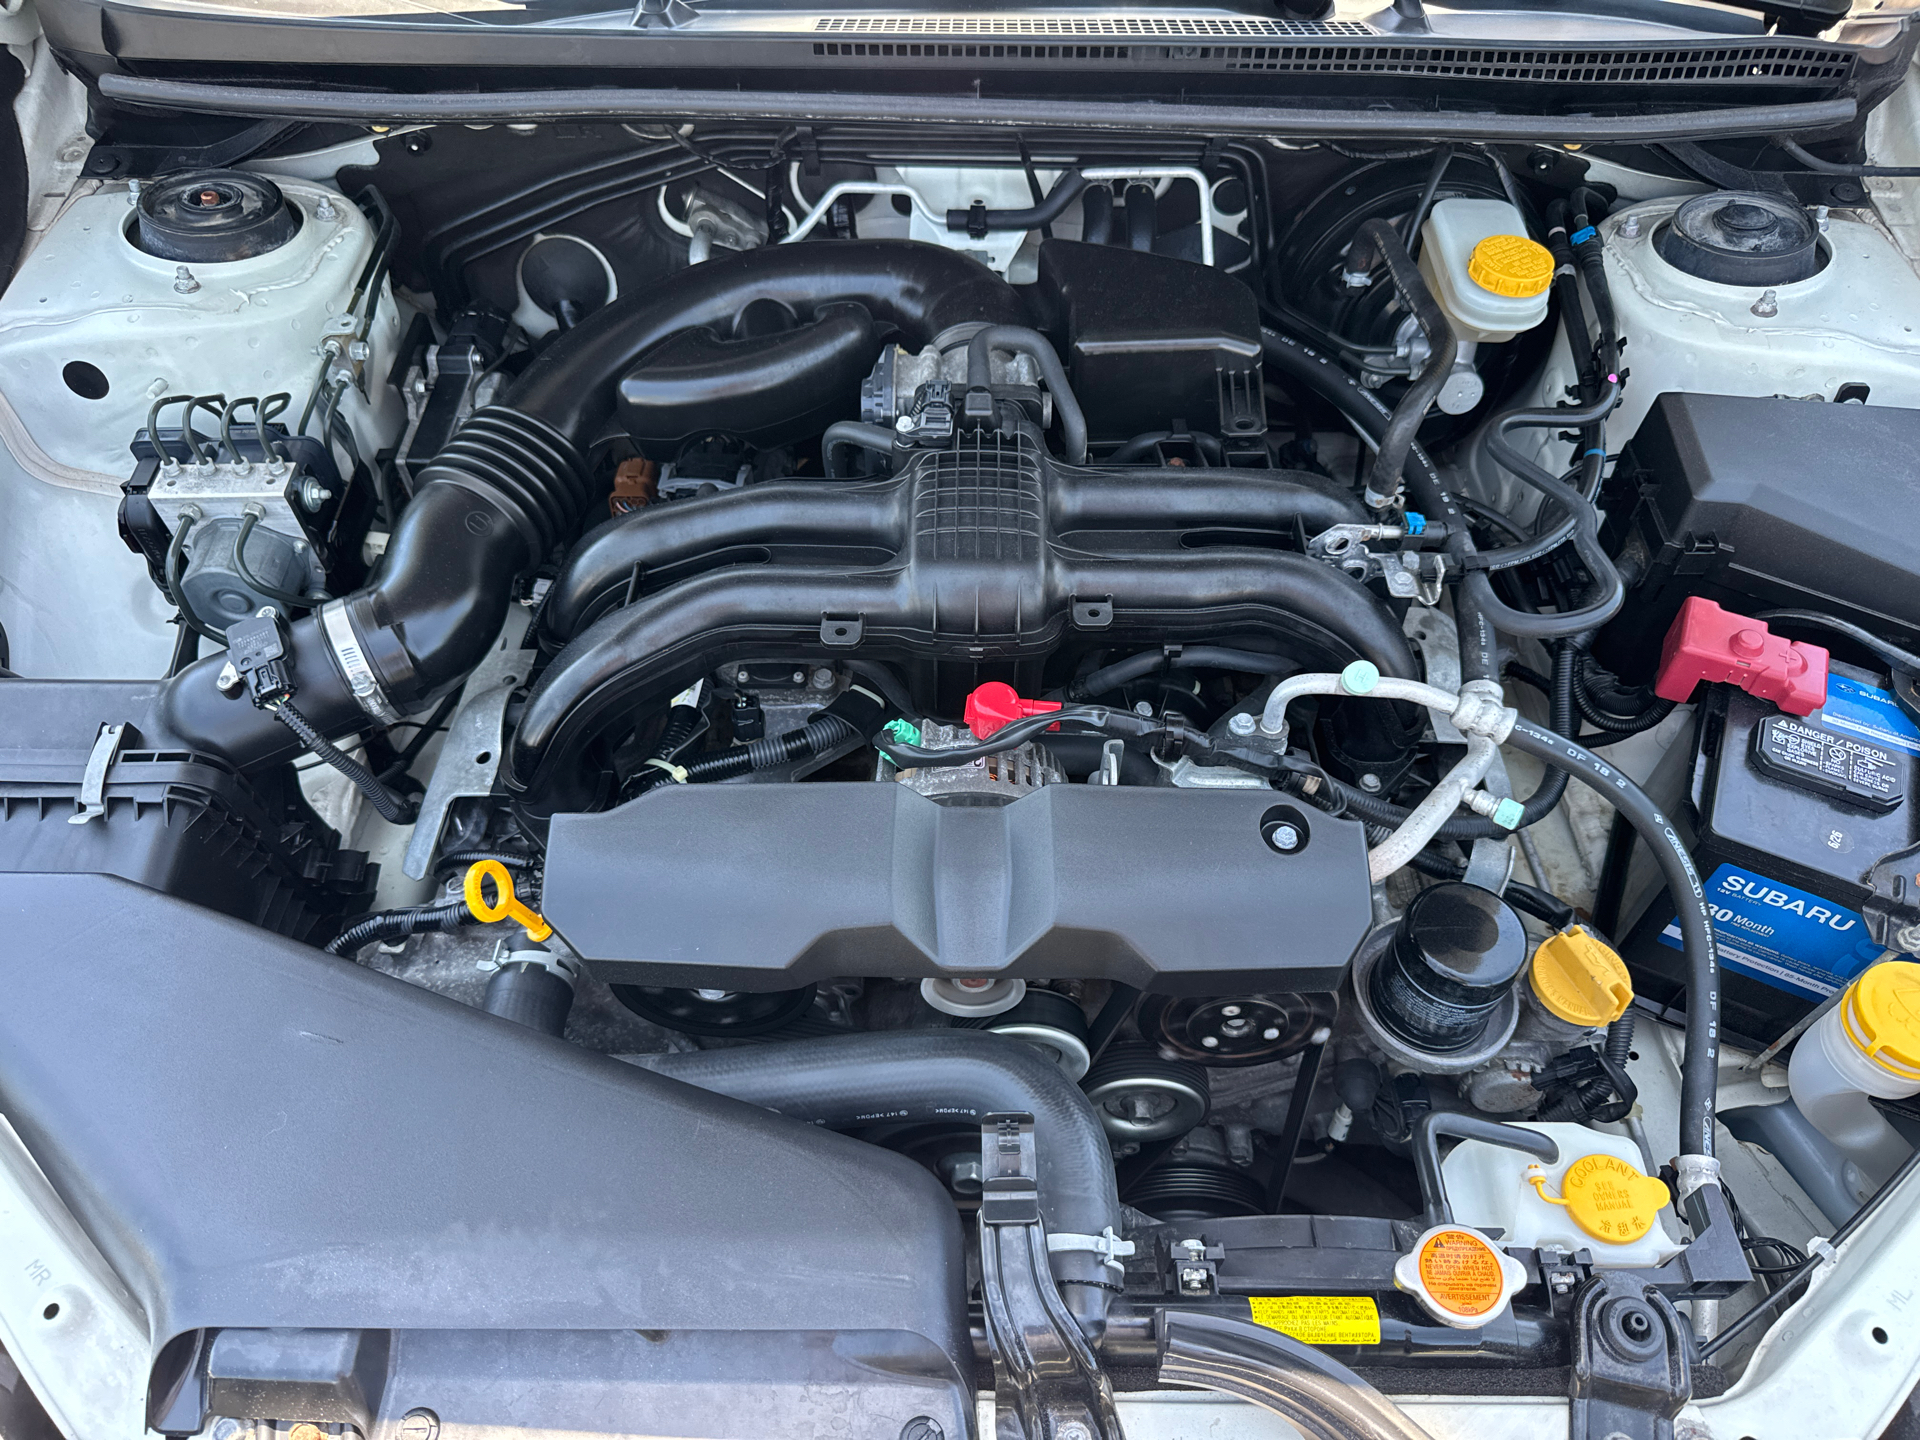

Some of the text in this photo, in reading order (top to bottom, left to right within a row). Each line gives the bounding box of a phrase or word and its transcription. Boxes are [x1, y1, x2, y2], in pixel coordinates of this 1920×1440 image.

[1790, 723, 1835, 744] DANGER
[1846, 741, 1888, 761] POISON
[1566, 747, 1587, 762] DF
[1593, 762, 1610, 777] 18
[1615, 778, 1627, 789] 2
[1828, 830, 1843, 849] 6/26
[1717, 887, 1762, 907] 12V BATTERY
[1722, 875, 1856, 931] SUBARU
[1733, 915, 1775, 936] Month
[1741, 955, 1779, 973] Protection
[1783, 972, 1820, 989] 85-Month
[1432, 1002, 1466, 1014] CAUTION
[1556, 994, 1592, 1017] MANUAL
[1709, 991, 1717, 1011] DF
[1708, 1020, 1717, 1038] 18
[1707, 1047, 1715, 1059] 2
[1570, 1157, 1639, 1188] COOLANT
[1594, 1180, 1614, 1192] SEE
[1595, 1199, 1635, 1212] MANUAL
[25, 1259, 52, 1286] MR
[1886, 1289, 1914, 1312] ML
